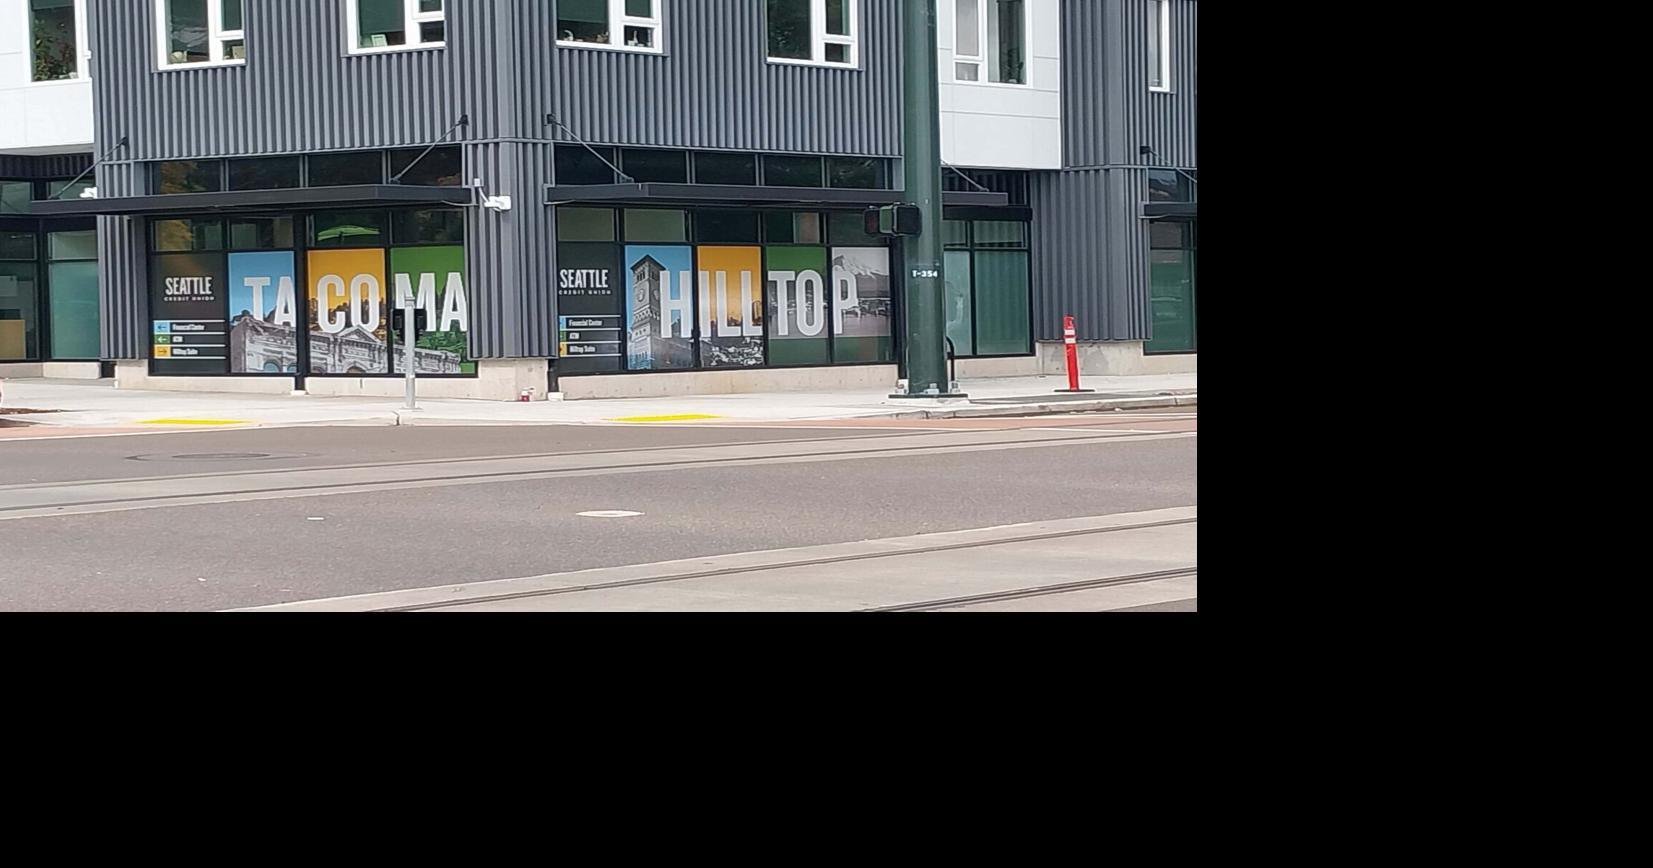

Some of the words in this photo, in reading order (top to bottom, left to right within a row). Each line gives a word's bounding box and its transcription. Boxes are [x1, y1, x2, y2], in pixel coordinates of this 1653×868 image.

[560, 269, 608, 288] SEATTLE
[912, 269, 938, 278] T-354
[165, 277, 212, 295] SEATTLE
[244, 272, 467, 334] TACOMA
[660, 268, 857, 338] HILLTOP
